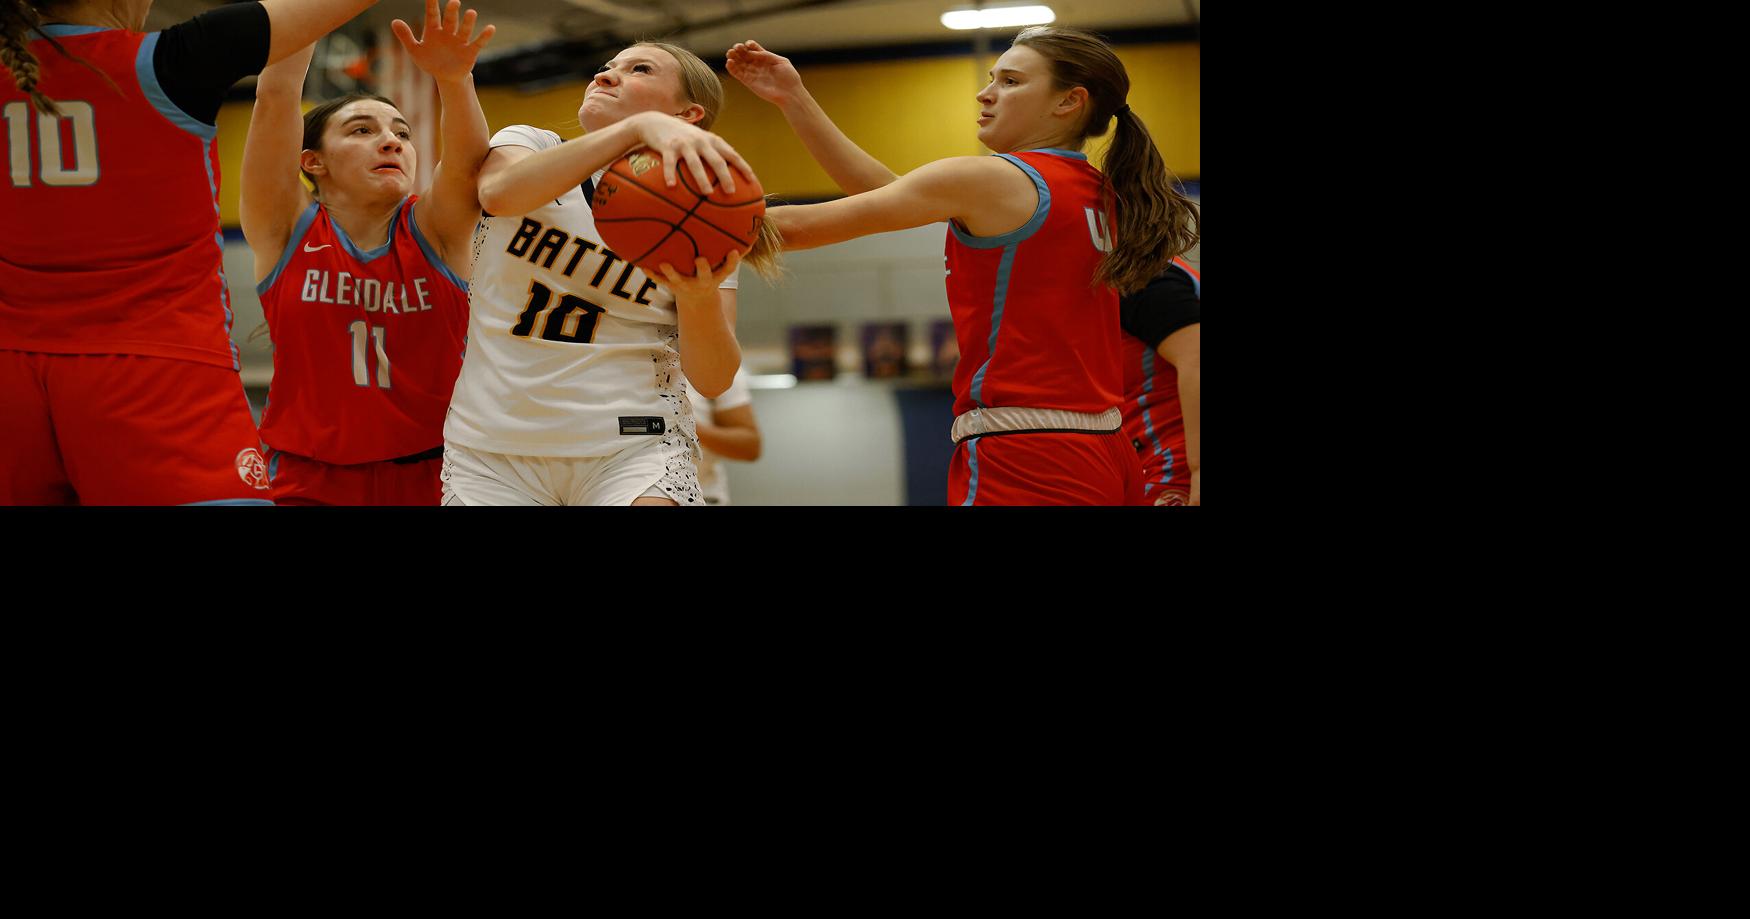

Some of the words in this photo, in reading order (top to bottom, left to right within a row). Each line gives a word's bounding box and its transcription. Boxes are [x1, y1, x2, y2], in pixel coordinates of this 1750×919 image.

[3, 101, 100, 187] 10
[506, 217, 657, 306] BATTLE
[510, 279, 608, 344] 10
[348, 320, 392, 389] 11
[652, 422, 661, 430] M
